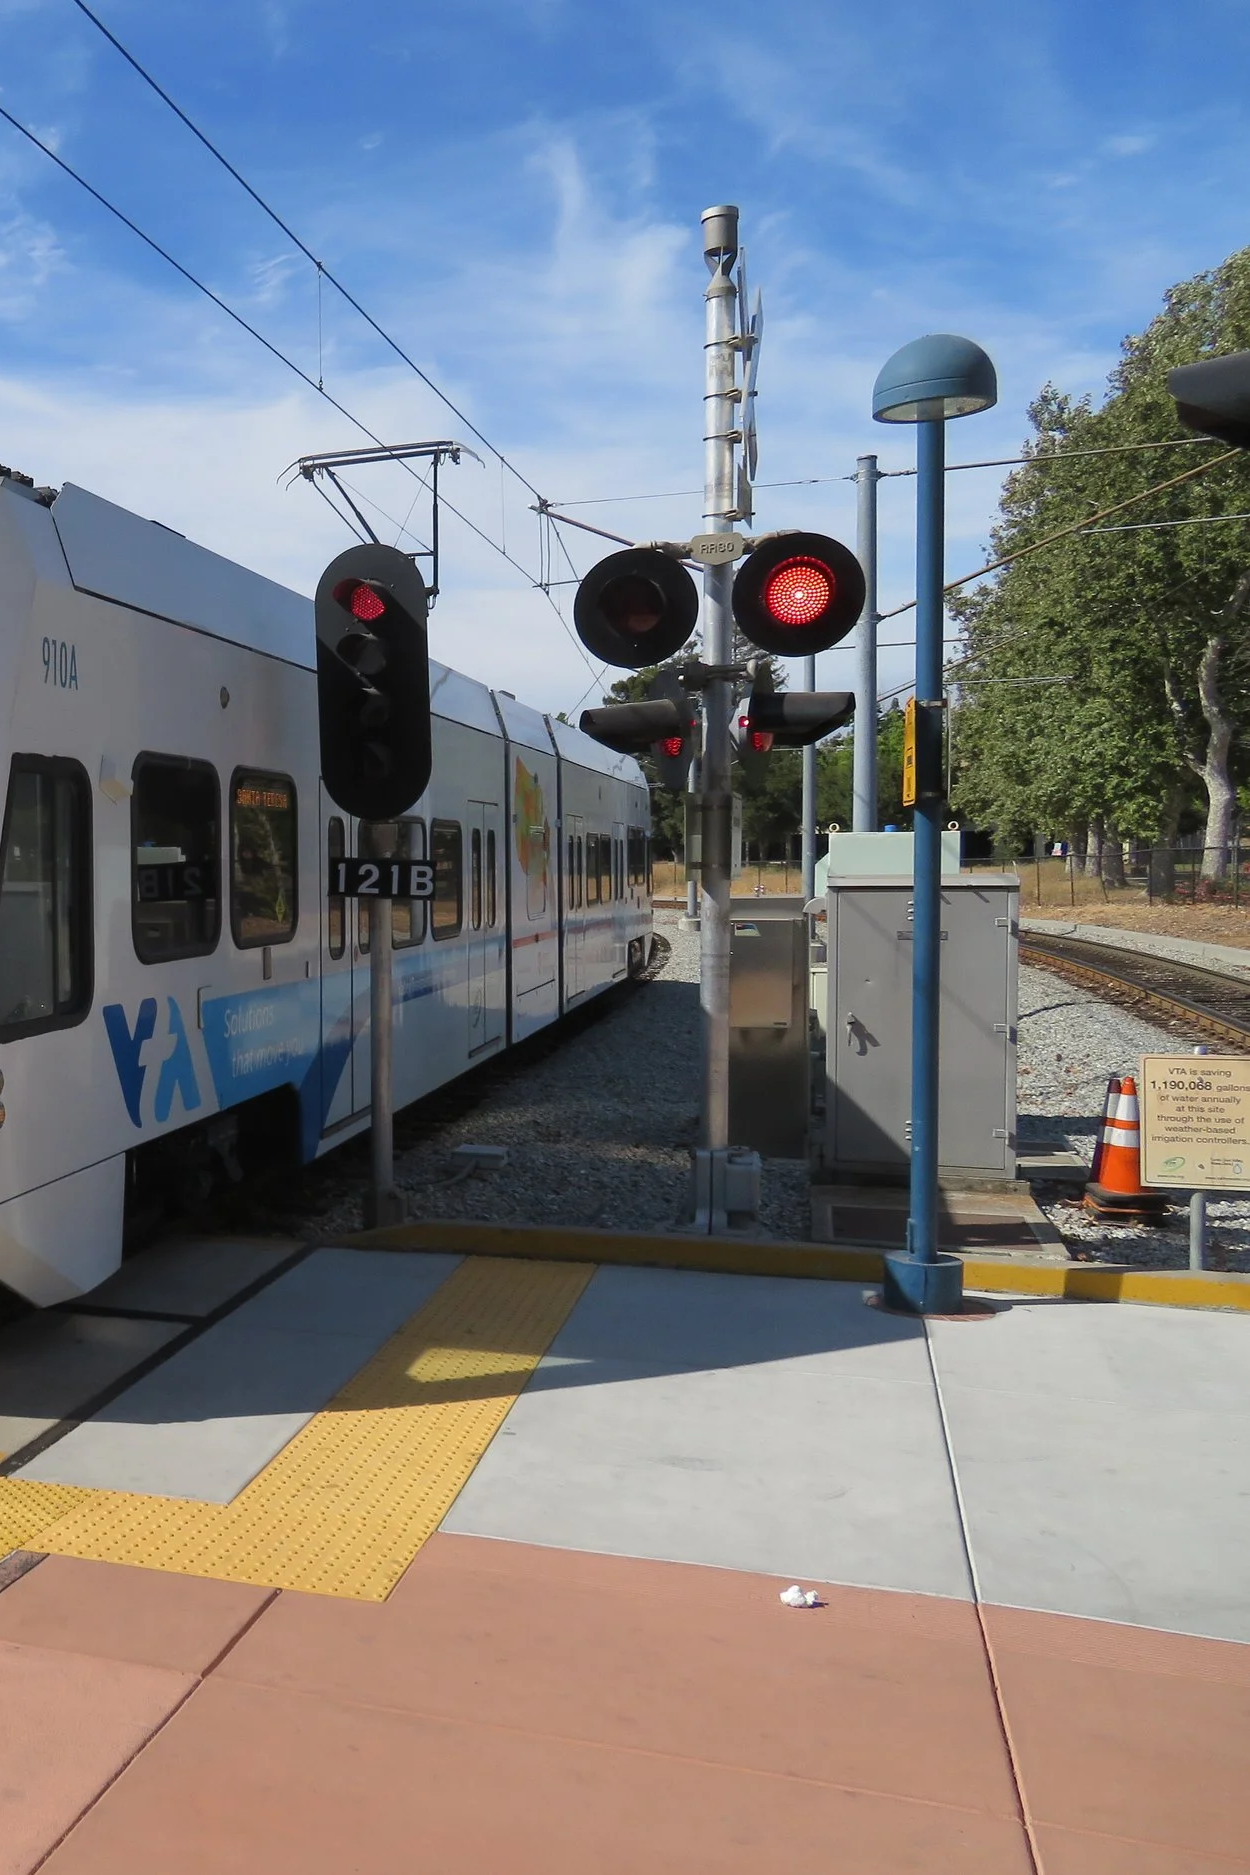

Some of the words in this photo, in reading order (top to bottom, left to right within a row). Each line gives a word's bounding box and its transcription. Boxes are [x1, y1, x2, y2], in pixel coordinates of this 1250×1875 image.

[42, 636, 79, 691] 910A
[337, 862, 434, 896] 121B
[223, 1003, 275, 1039] Solutions
[1168, 1067, 1187, 1075] VTA
[1189, 1067, 1198, 1076] is
[1200, 1068, 1232, 1078] saving
[1216, 1084, 1250, 1092] gallons
[1159, 1094, 1169, 1102] of
[1201, 1096, 1241, 1105] annually
[1157, 1114, 1194, 1123] through
[1196, 1115, 1212, 1123] the
[1164, 1125, 1236, 1134] weather-based
[1151, 1134, 1193, 1143] irrigation
